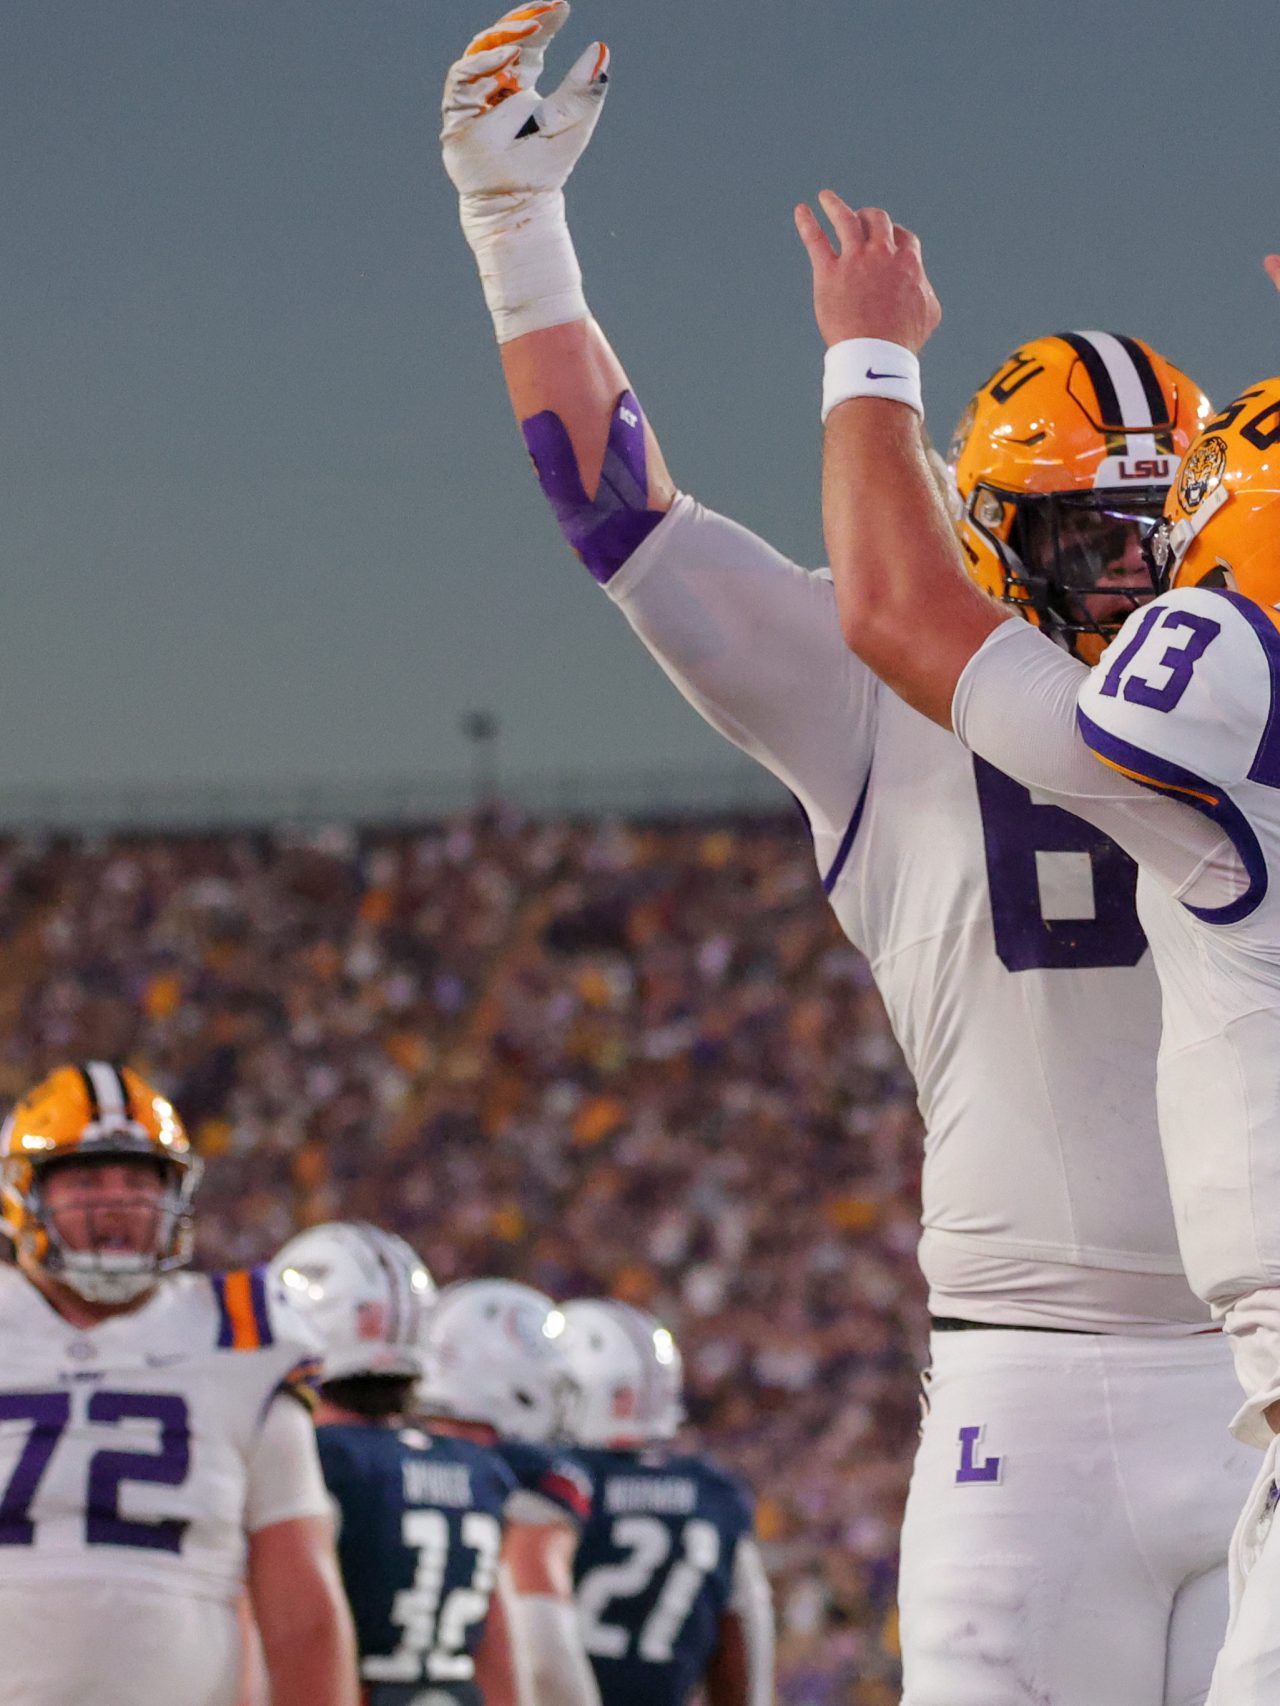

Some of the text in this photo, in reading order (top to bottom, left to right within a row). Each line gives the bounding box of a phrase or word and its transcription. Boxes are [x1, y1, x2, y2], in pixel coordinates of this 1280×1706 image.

[1117, 459, 1169, 480] LSU
[1099, 605, 1221, 714] 13
[0, 1391, 191, 1554] 72
[955, 1426, 1000, 1483] L
